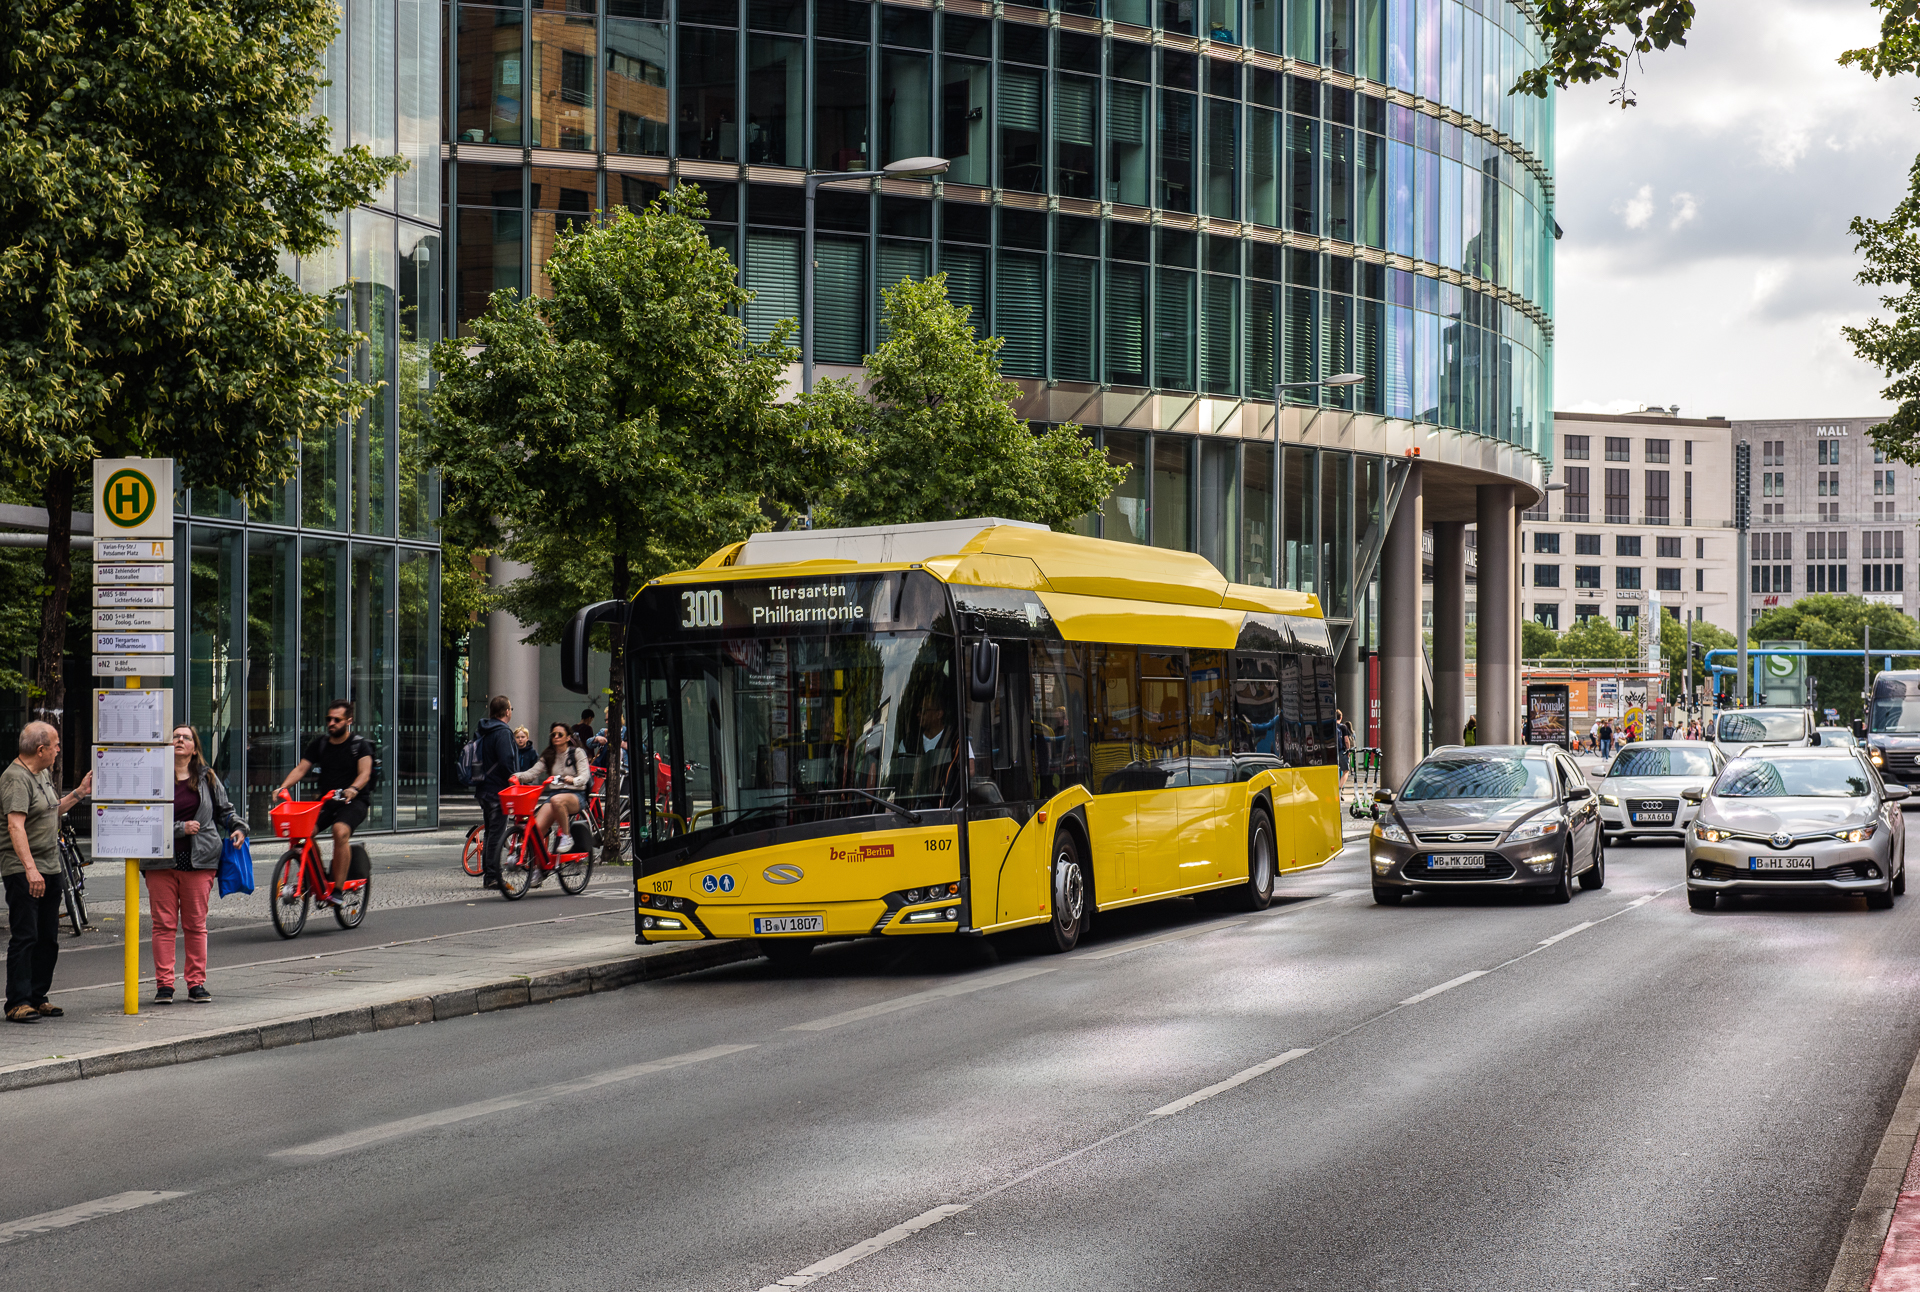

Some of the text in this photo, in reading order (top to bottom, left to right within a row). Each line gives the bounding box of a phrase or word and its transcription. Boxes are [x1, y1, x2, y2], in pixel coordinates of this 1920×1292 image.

[1816, 425, 1849, 437] MALL
[115, 482, 140, 514] H
[153, 542, 164, 556] A
[768, 583, 846, 601] Tiergarten
[681, 589, 723, 628] 300
[752, 601, 864, 625] Philharmonie
[102, 613, 114, 621] 200
[102, 637, 114, 645] 300
[101, 660, 111, 668] N2
[1771, 646, 1794, 677] S
[1530, 697, 1566, 714] Pyronale
[100, 845, 139, 854] Nachtlinie
[924, 839, 952, 852] 1807
[829, 846, 892, 861] be Berlin
[1433, 856, 1484, 866] WB MK 2000
[1756, 858, 1812, 869] B HI 3044
[652, 880, 673, 893] 1807
[765, 917, 818, 931] B V 1807
